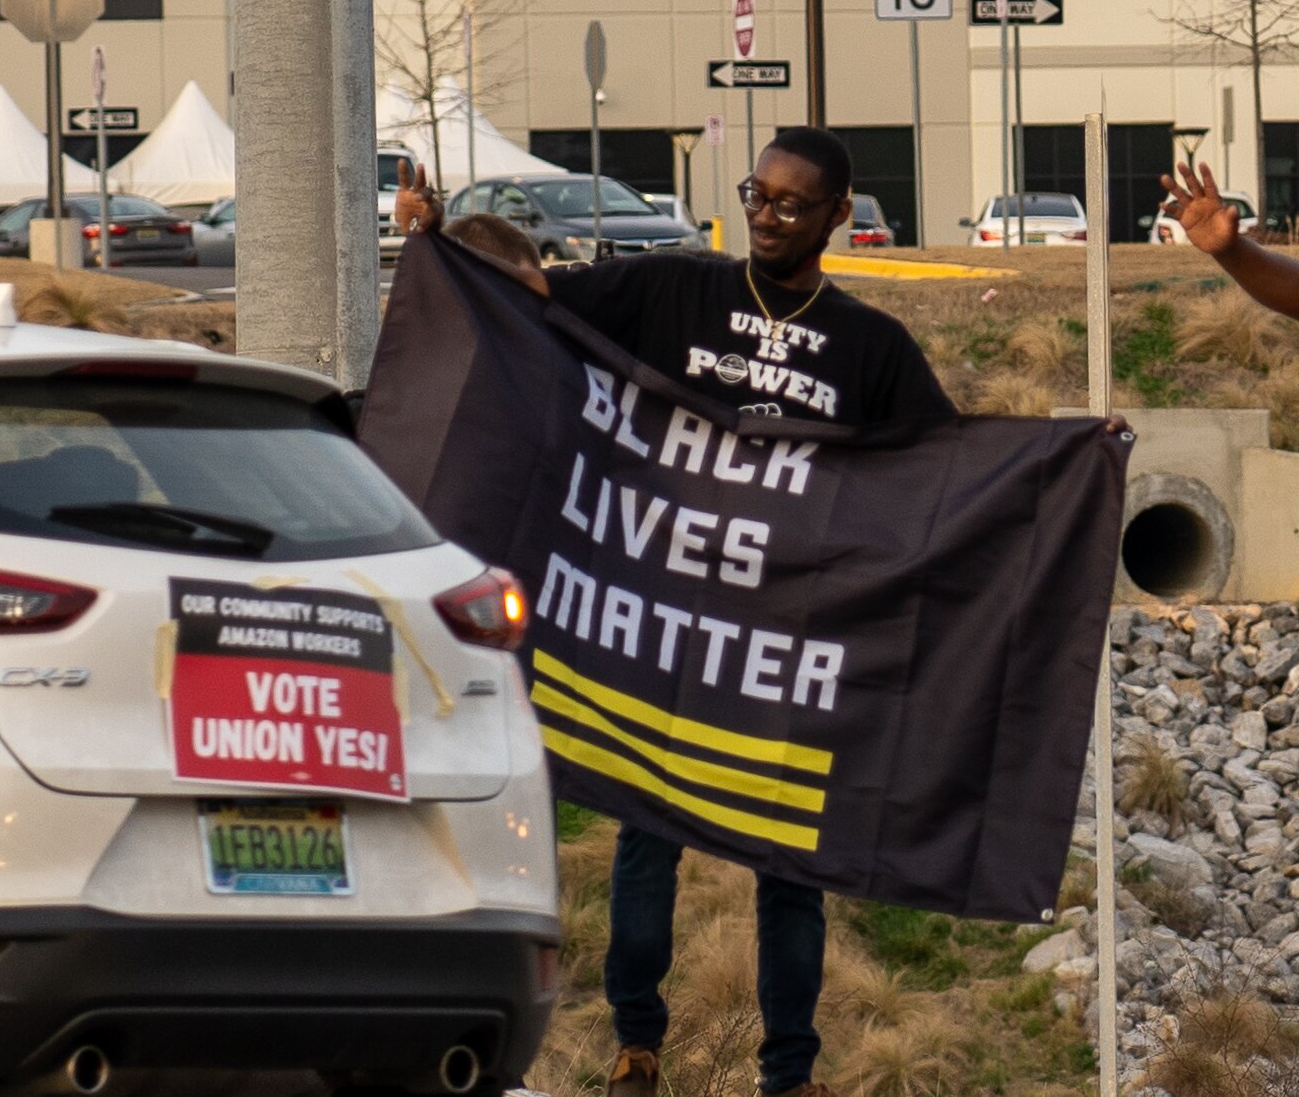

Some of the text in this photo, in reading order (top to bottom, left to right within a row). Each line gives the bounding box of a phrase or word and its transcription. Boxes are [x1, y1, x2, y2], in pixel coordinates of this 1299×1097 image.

[733, 67, 781, 79] ONE WAY
[730, 312, 827, 352] UNITY
[756, 337, 789, 361] IS
[582, 362, 819, 494] BLACK
[561, 452, 770, 588] LIVES
[181, 595, 385, 633] OUR COMMUNITY SUPPORTS
[536, 552, 845, 711] MATTER
[217, 626, 362, 657] AMAZON WORKERS
[246, 671, 341, 717] VOTE
[192, 717, 389, 772] UNION YES!
